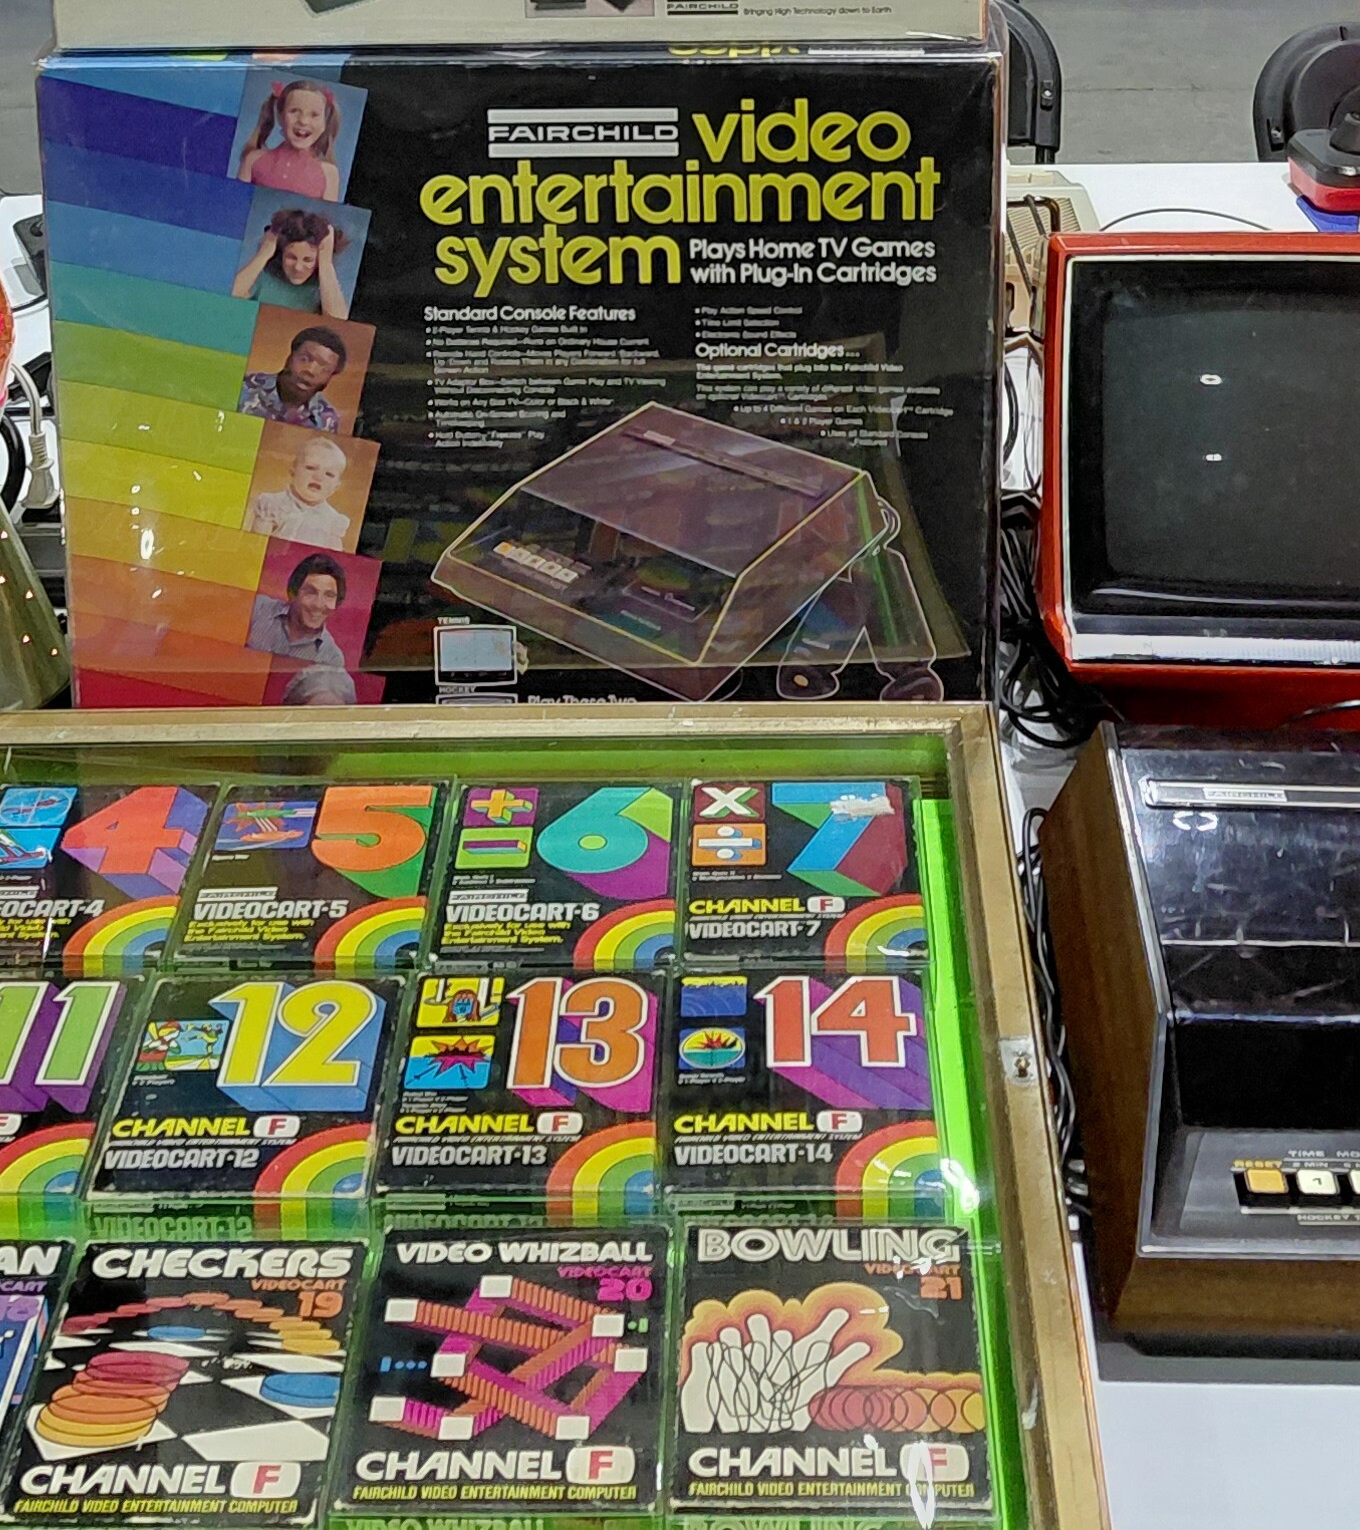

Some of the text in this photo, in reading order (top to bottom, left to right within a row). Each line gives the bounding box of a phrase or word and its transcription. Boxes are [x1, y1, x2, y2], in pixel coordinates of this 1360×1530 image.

[488, 98, 912, 163] FAIRCHILD video
[419, 157, 941, 225] entertainment
[434, 223, 681, 298] system
[690, 237, 936, 262] Plays Home TV Games
[690, 261, 938, 287] with Plug-In Cartridges
[424, 306, 636, 322] Standard Console Features
[695, 343, 760, 361] Optional
[60, 786, 186, 874] 4
[307, 784, 434, 871] 5
[536, 785, 653, 872] 6
[771, 782, 888, 896] 7
[192, 898, 351, 922] VIDEOCART-5
[444, 901, 601, 924] VIDEOCART-6
[688, 897, 807, 916] CHANNEL
[686, 917, 821, 941] VIDEOCART-7
[216, 980, 382, 1089] 12
[504, 976, 646, 1089] 13
[755, 975, 916, 1069] 14
[111, 1116, 250, 1138] CHANNEL
[102, 1147, 260, 1171] VIDEOCART-12
[390, 1144, 548, 1167] VIDEOCART-13
[673, 1141, 834, 1166] VIDEOCART-14
[1288, 1150, 1325, 1158] TIME
[397, 1242, 654, 1266] VIDEO WHIZBALL
[697, 1228, 961, 1263] BOWLING
[92, 1246, 353, 1279] CHECKERS
